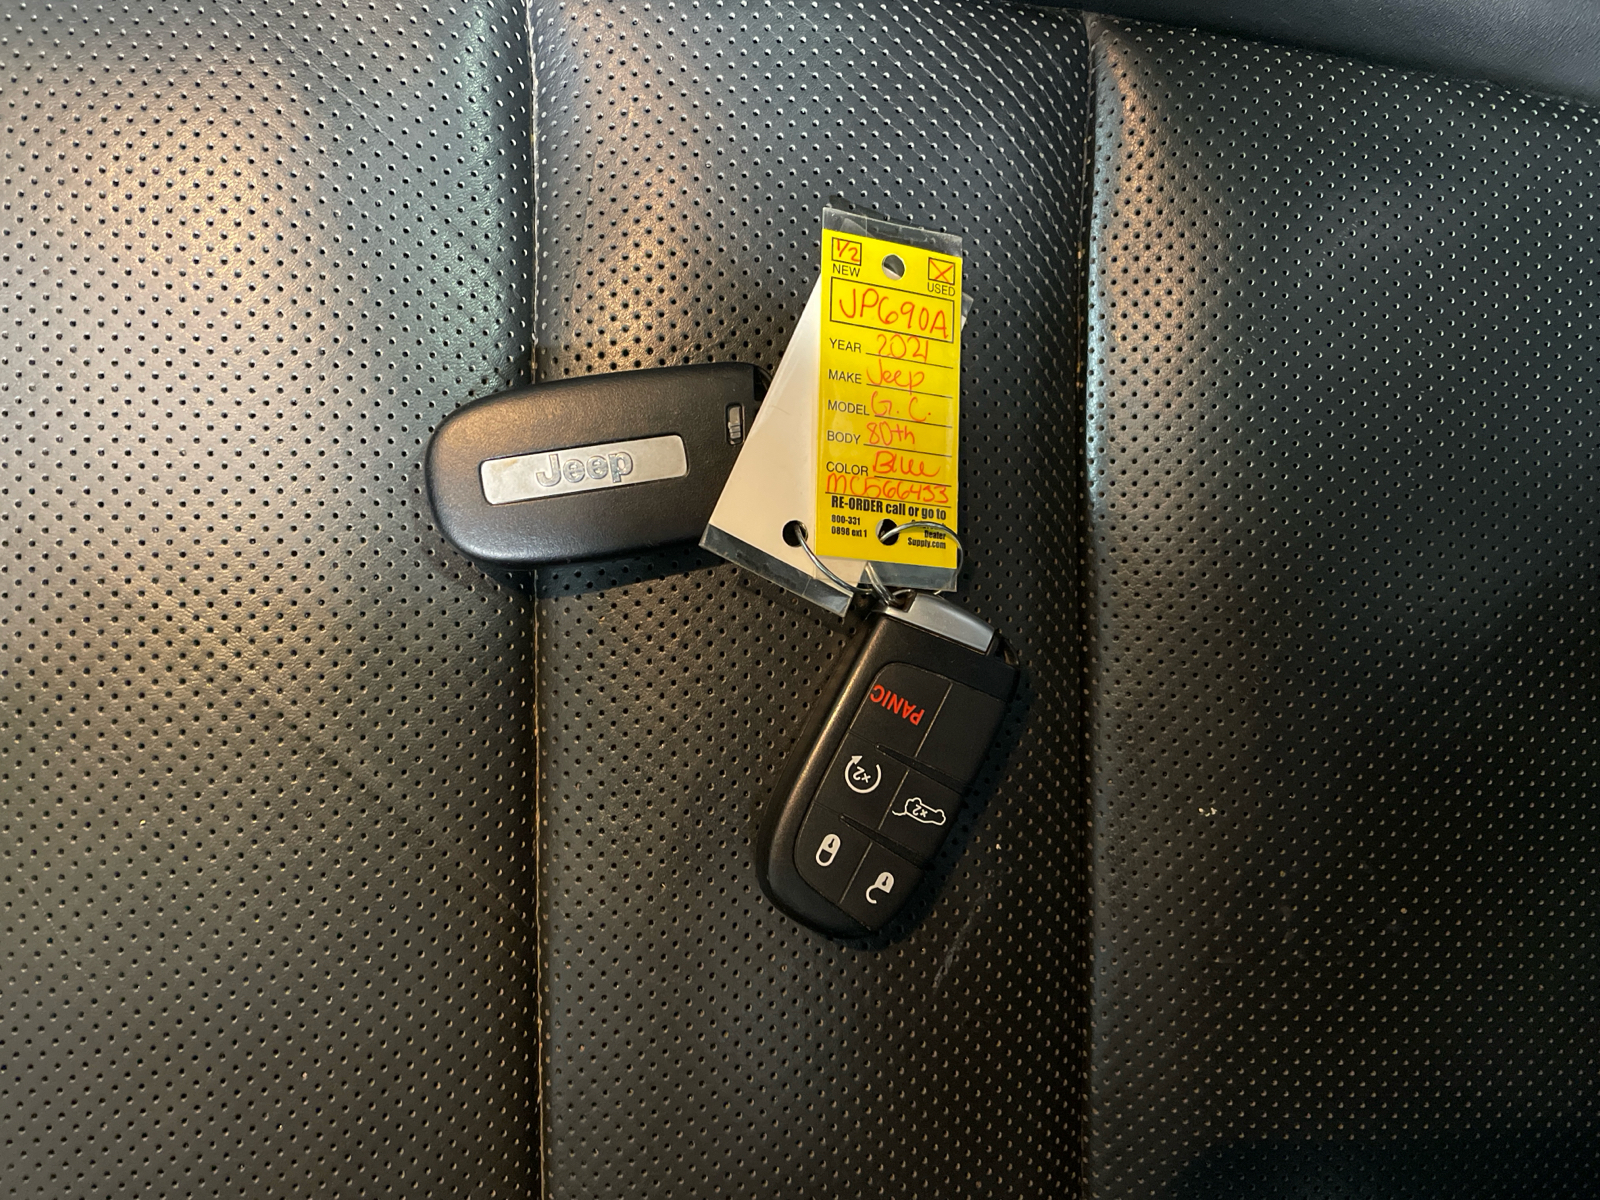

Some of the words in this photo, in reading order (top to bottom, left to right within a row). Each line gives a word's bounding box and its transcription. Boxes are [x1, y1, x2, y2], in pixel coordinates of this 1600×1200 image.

[832, 263, 861, 278] NEW
[927, 282, 956, 297] USED
[839, 288, 949, 339] JP690A
[829, 338, 862, 354] YEAR
[877, 333, 929, 363] 2021
[828, 369, 862, 384] MAKE
[866, 358, 925, 395] Jeep
[828, 399, 870, 416] MODEL
[827, 430, 861, 445] BODY
[866, 421, 916, 446] 80th
[535, 451, 633, 488] Jeep
[826, 461, 869, 476] COLOR
[873, 450, 941, 477] Blue
[831, 495, 883, 513] RE-ORDER
[885, 503, 906, 516] call
[908, 506, 920, 517] or
[921, 507, 934, 520] go
[936, 508, 947, 520] to
[831, 514, 861, 526] 800-331
[831, 526, 850, 536] 0898
[851, 529, 863, 537] ext
[907, 537, 947, 550] Supply.com
[869, 684, 925, 726] PANIC
